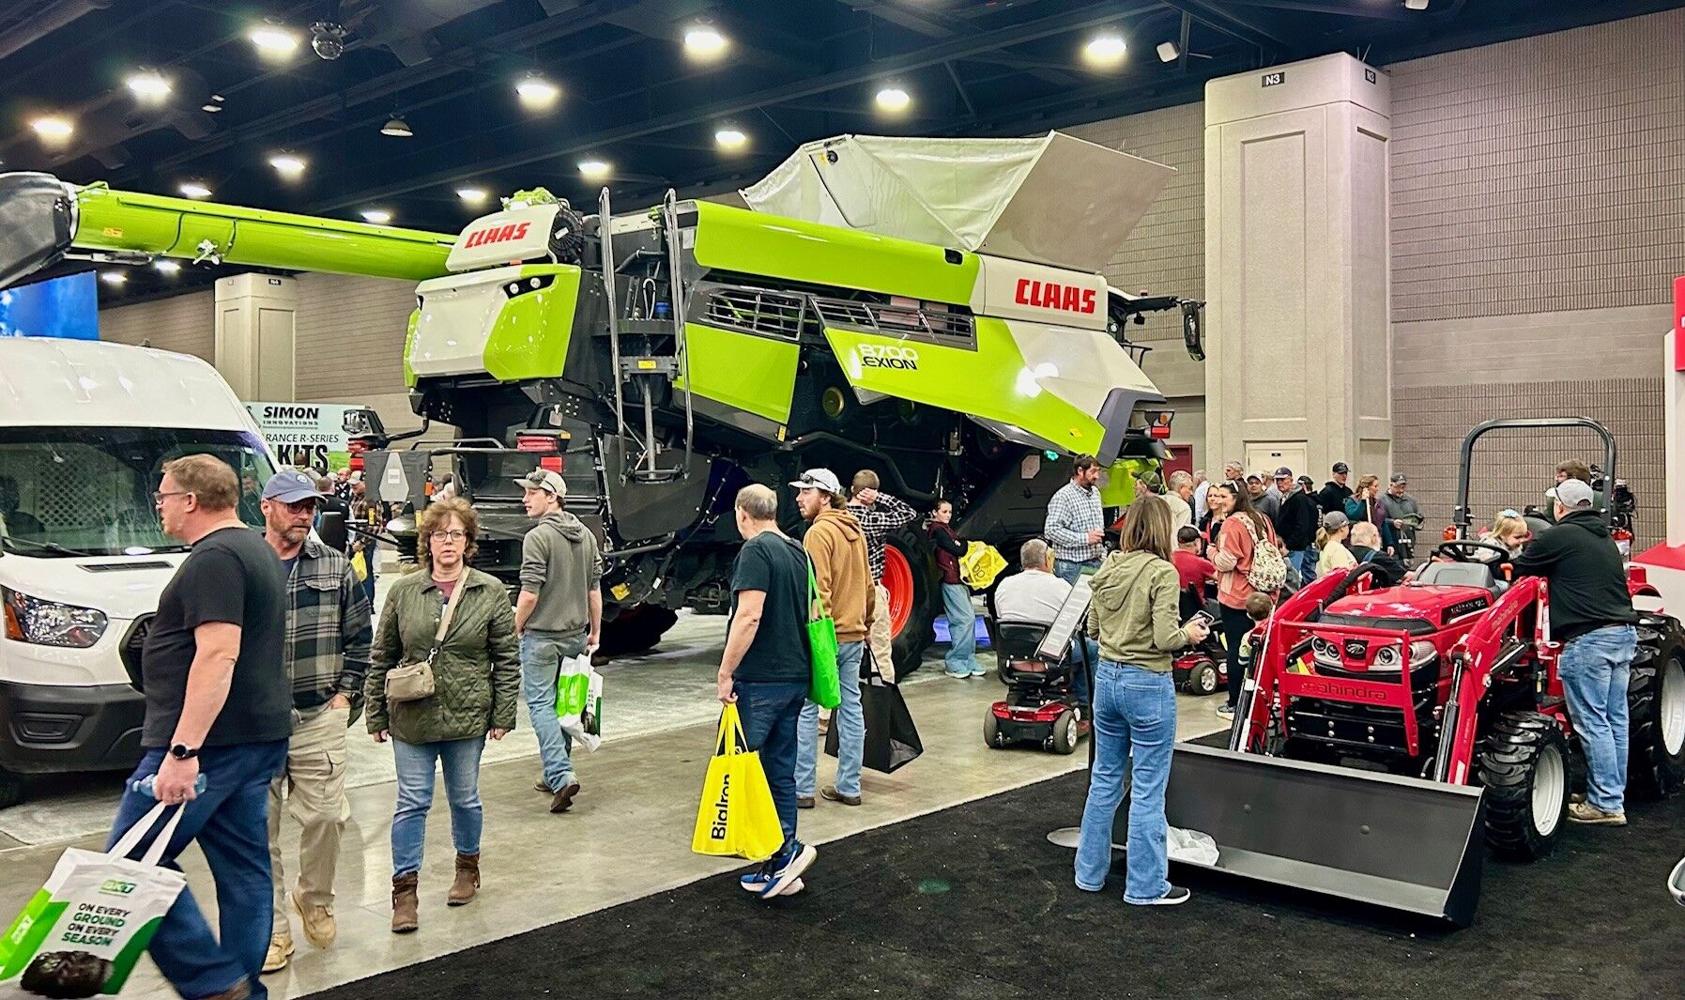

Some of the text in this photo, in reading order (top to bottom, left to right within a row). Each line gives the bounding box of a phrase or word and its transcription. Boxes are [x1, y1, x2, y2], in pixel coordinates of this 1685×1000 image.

[1265, 73, 1280, 86] N3
[464, 222, 531, 249] CLAAS
[1015, 278, 1096, 314] CLAAS
[857, 344, 920, 360] 8700
[861, 356, 918, 371] EXION
[263, 406, 319, 419] SIMON
[300, 434, 339, 443] R-SERIES
[277, 444, 329, 476] KITS
[79, 903, 131, 918] ON EVERY
[73, 912, 125, 928] GROUND
[67, 923, 120, 936] ON EVERY
[61, 932, 113, 946] SEASON
